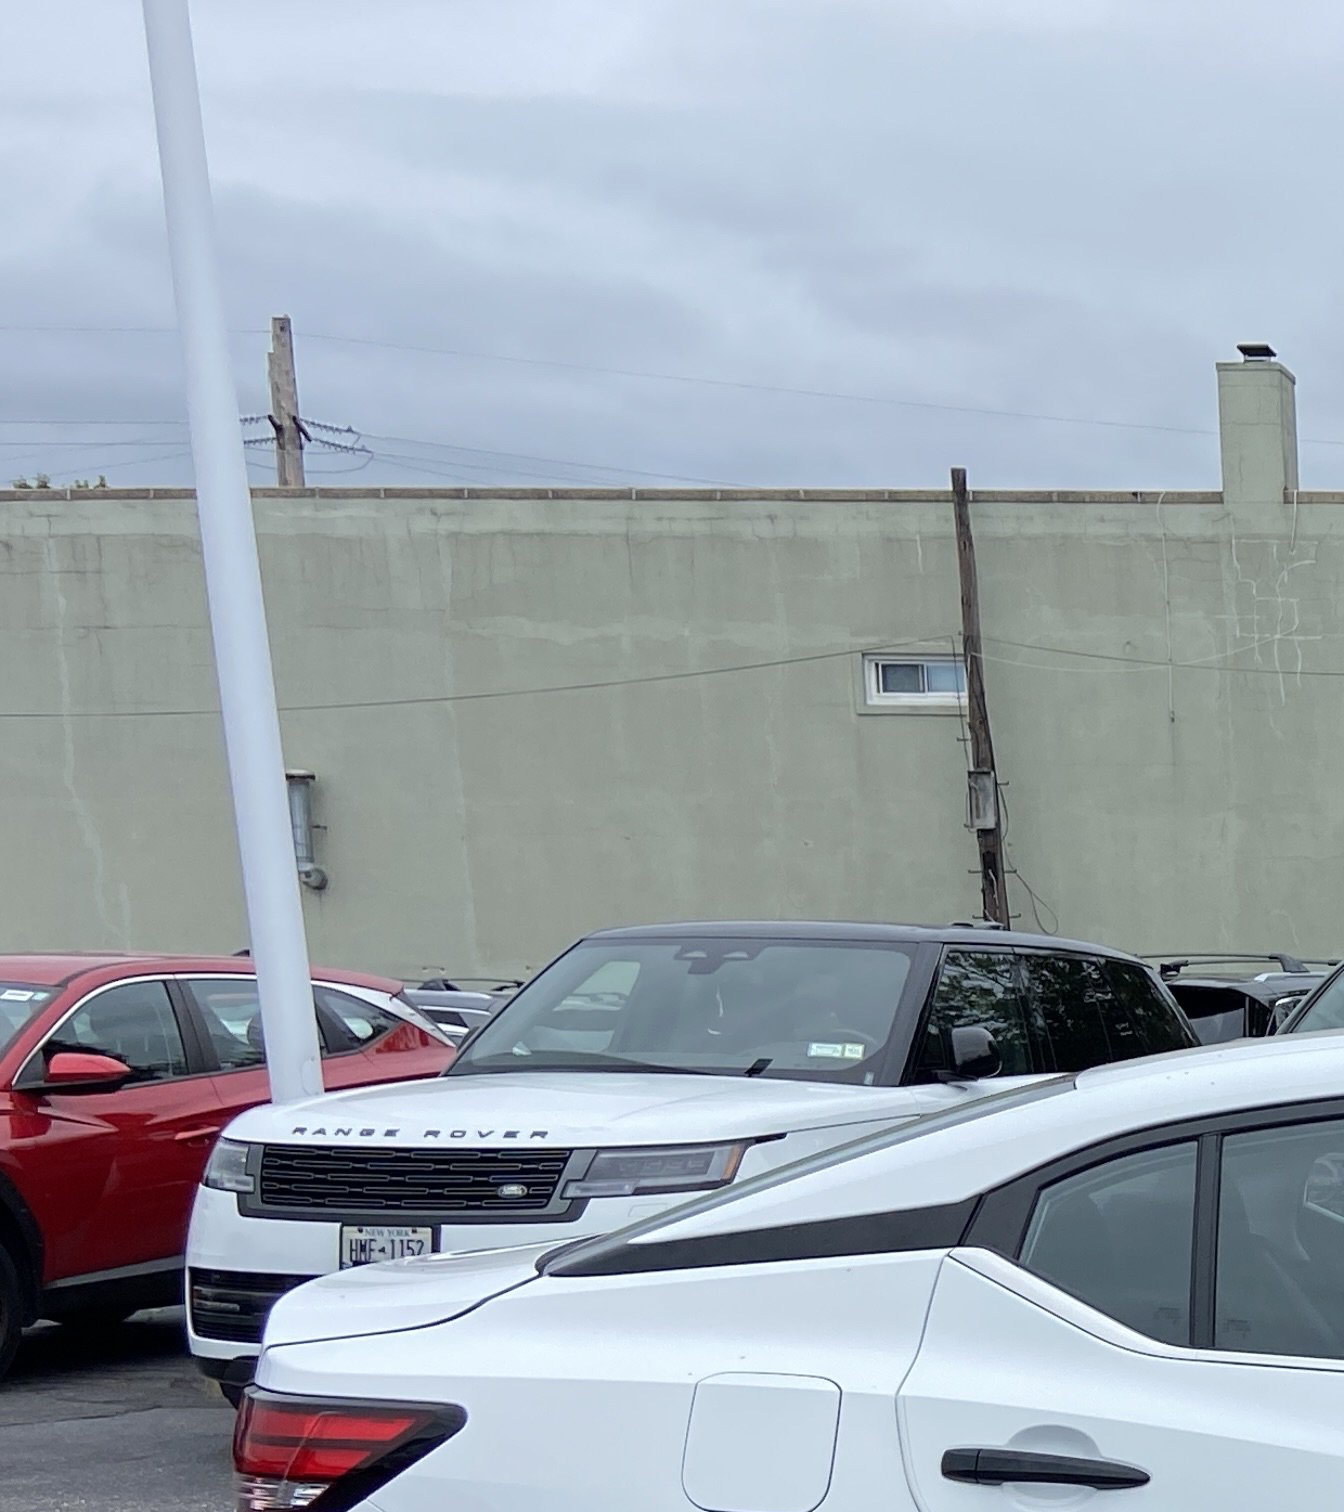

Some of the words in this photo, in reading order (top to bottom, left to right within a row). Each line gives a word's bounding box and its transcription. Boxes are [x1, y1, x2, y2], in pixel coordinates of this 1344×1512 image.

[292, 1127, 400, 1137] RANGE
[424, 1129, 549, 1139] ROVER
[364, 1228, 384, 1237] NEW
[387, 1228, 411, 1237] YORK
